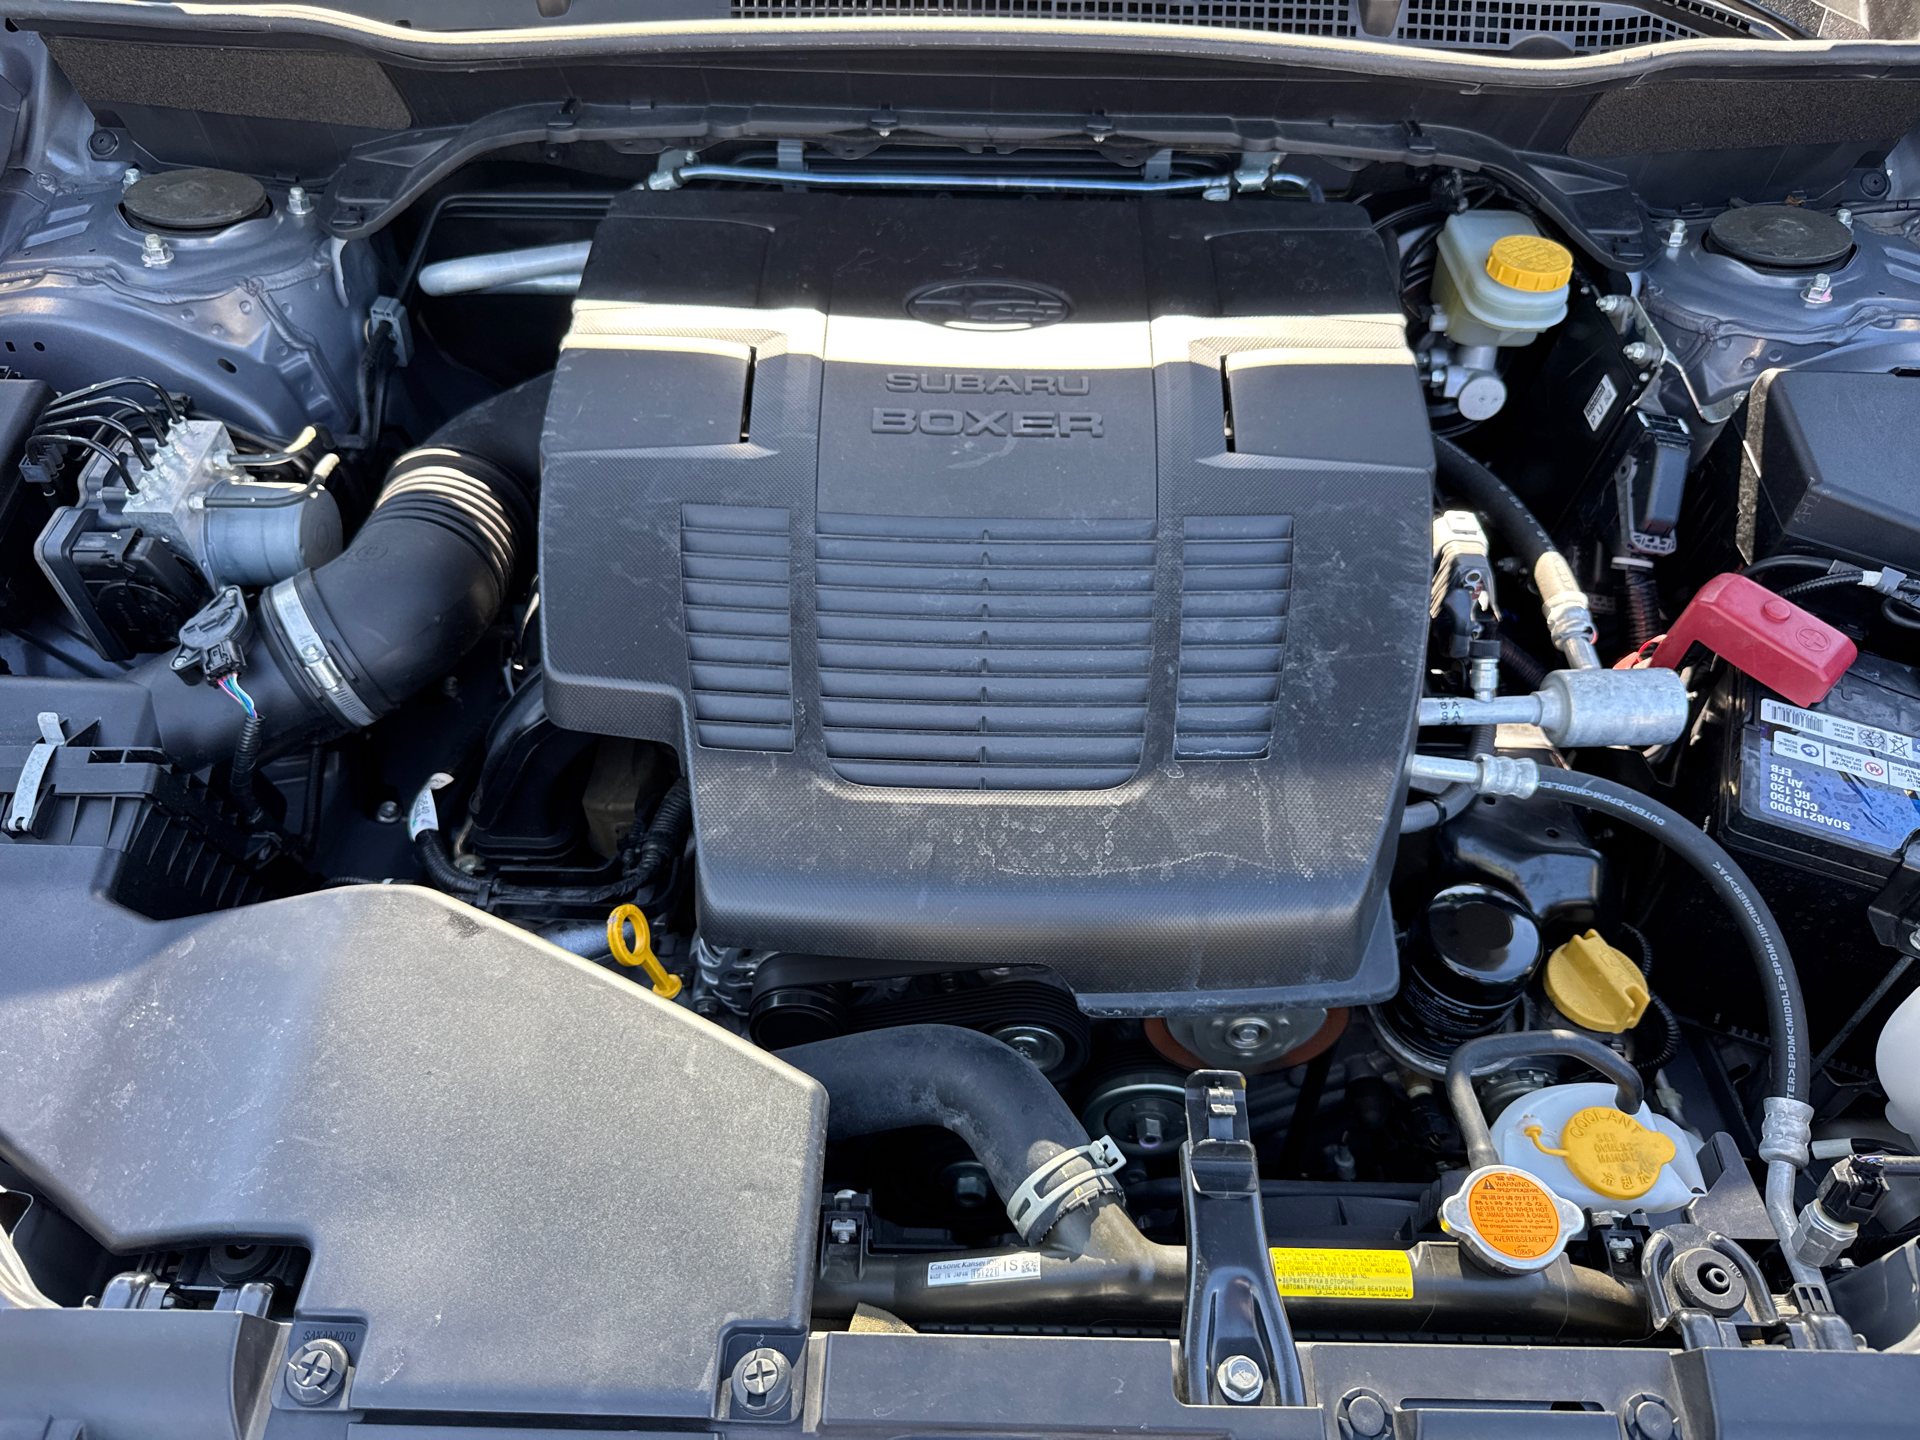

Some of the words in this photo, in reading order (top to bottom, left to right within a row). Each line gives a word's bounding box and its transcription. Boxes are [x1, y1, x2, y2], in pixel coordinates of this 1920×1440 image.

[886, 373, 1090, 396] SUBARU
[871, 407, 1104, 438] BOXER
[1770, 764, 1792, 776] EFB
[1770, 773, 1784, 784] 76
[1787, 778, 1803, 788] Ah
[1770, 782, 1790, 794] 120
[1794, 788, 1810, 800] RC
[1770, 792, 1794, 804] 750
[1796, 798, 1818, 812] CCA
[1570, 1109, 1643, 1138] COOLANT
[1597, 1152, 1638, 1164] MANUAL
[303, 1330, 356, 1341] SAKAMOTO
